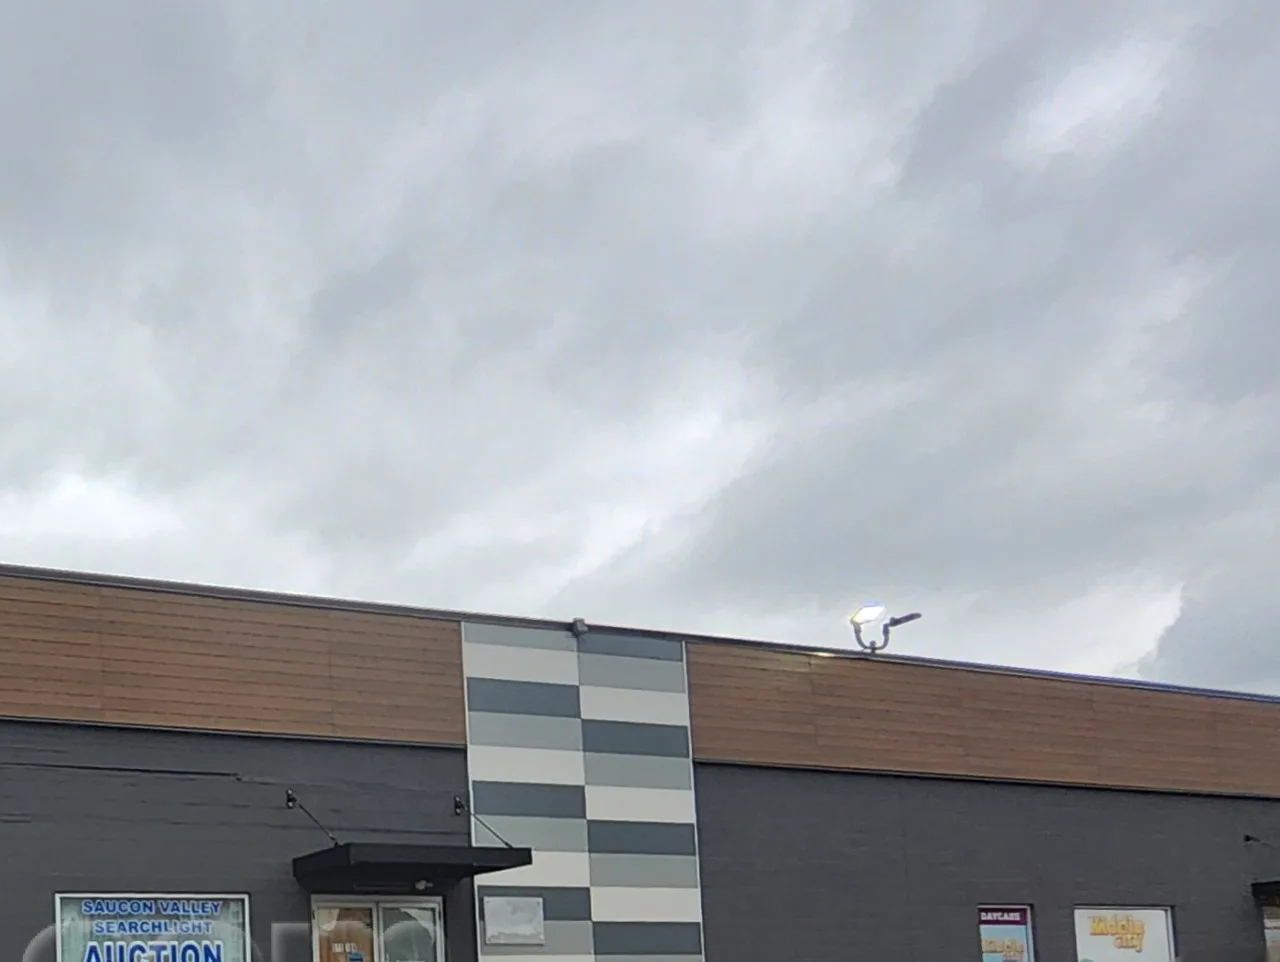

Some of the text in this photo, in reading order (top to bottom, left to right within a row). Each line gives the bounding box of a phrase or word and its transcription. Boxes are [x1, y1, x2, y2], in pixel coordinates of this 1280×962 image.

[83, 901, 221, 914] SAUCON VALLEY
[980, 913, 1021, 921] DAYCARE
[94, 920, 213, 934] SEARCHLIGHT
